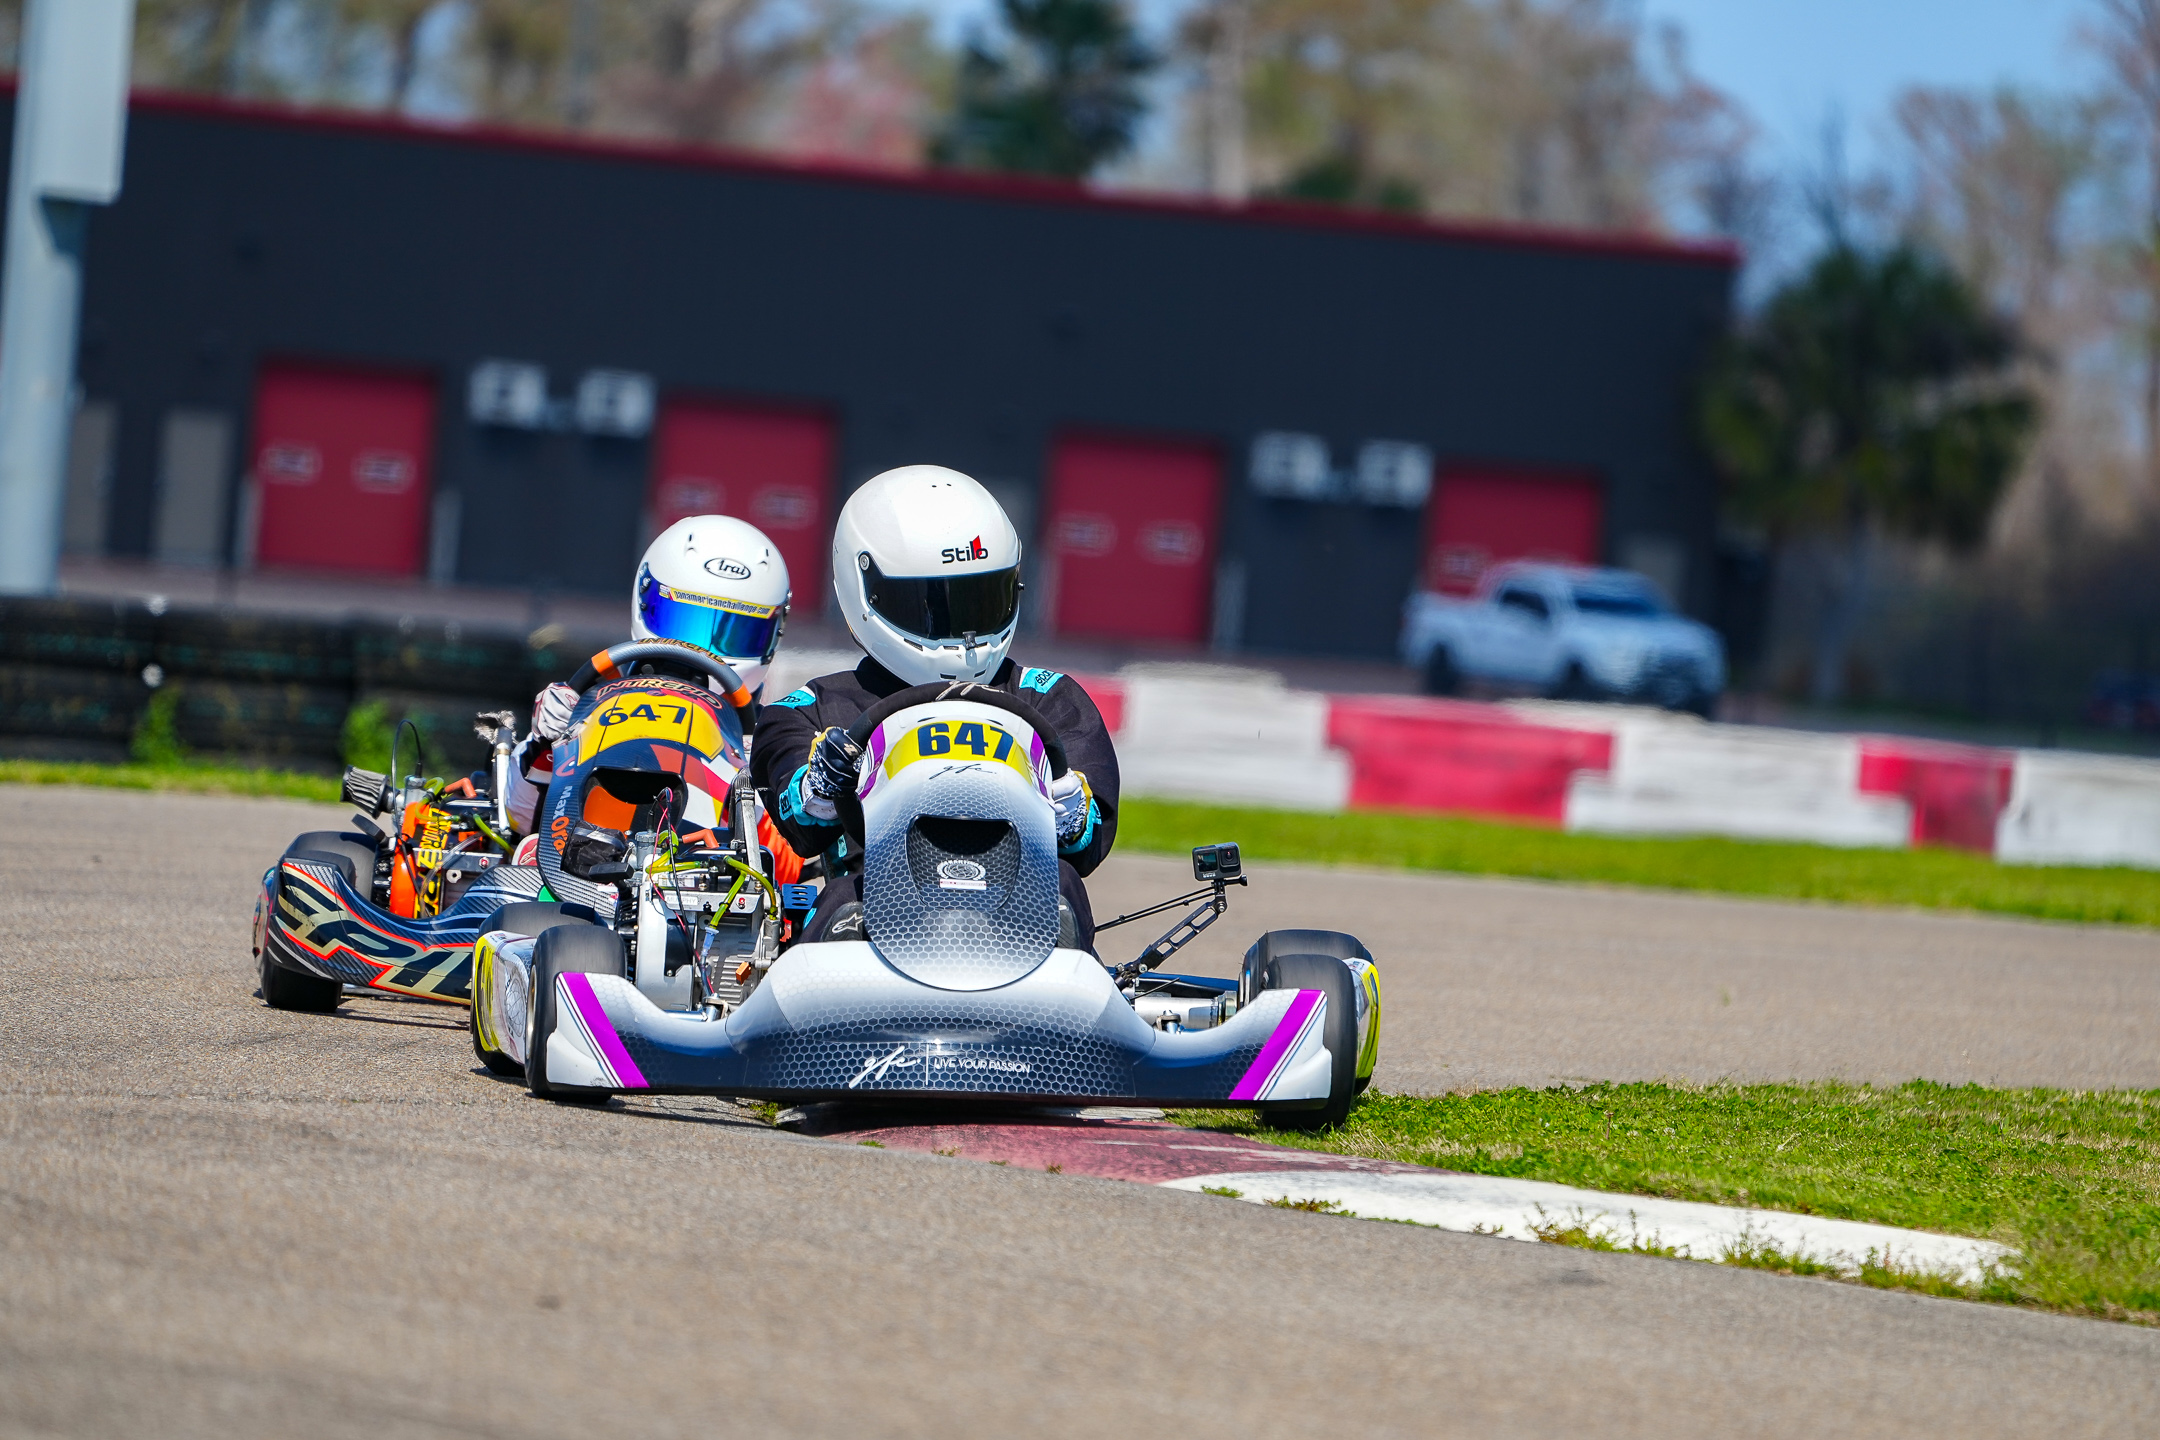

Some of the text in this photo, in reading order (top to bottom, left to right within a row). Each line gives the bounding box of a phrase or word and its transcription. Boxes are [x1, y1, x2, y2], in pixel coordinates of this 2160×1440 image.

[942, 535, 989, 564] Stilo
[719, 560, 746, 576] Arai
[596, 679, 724, 709] INTREPID
[599, 703, 688, 727] 647
[917, 722, 1014, 762] 647
[666, 896, 696, 904] MUPHY
[934, 1057, 957, 1069] LIVE
[958, 1058, 987, 1070] YOUR
[988, 1060, 1031, 1073] PASSION
